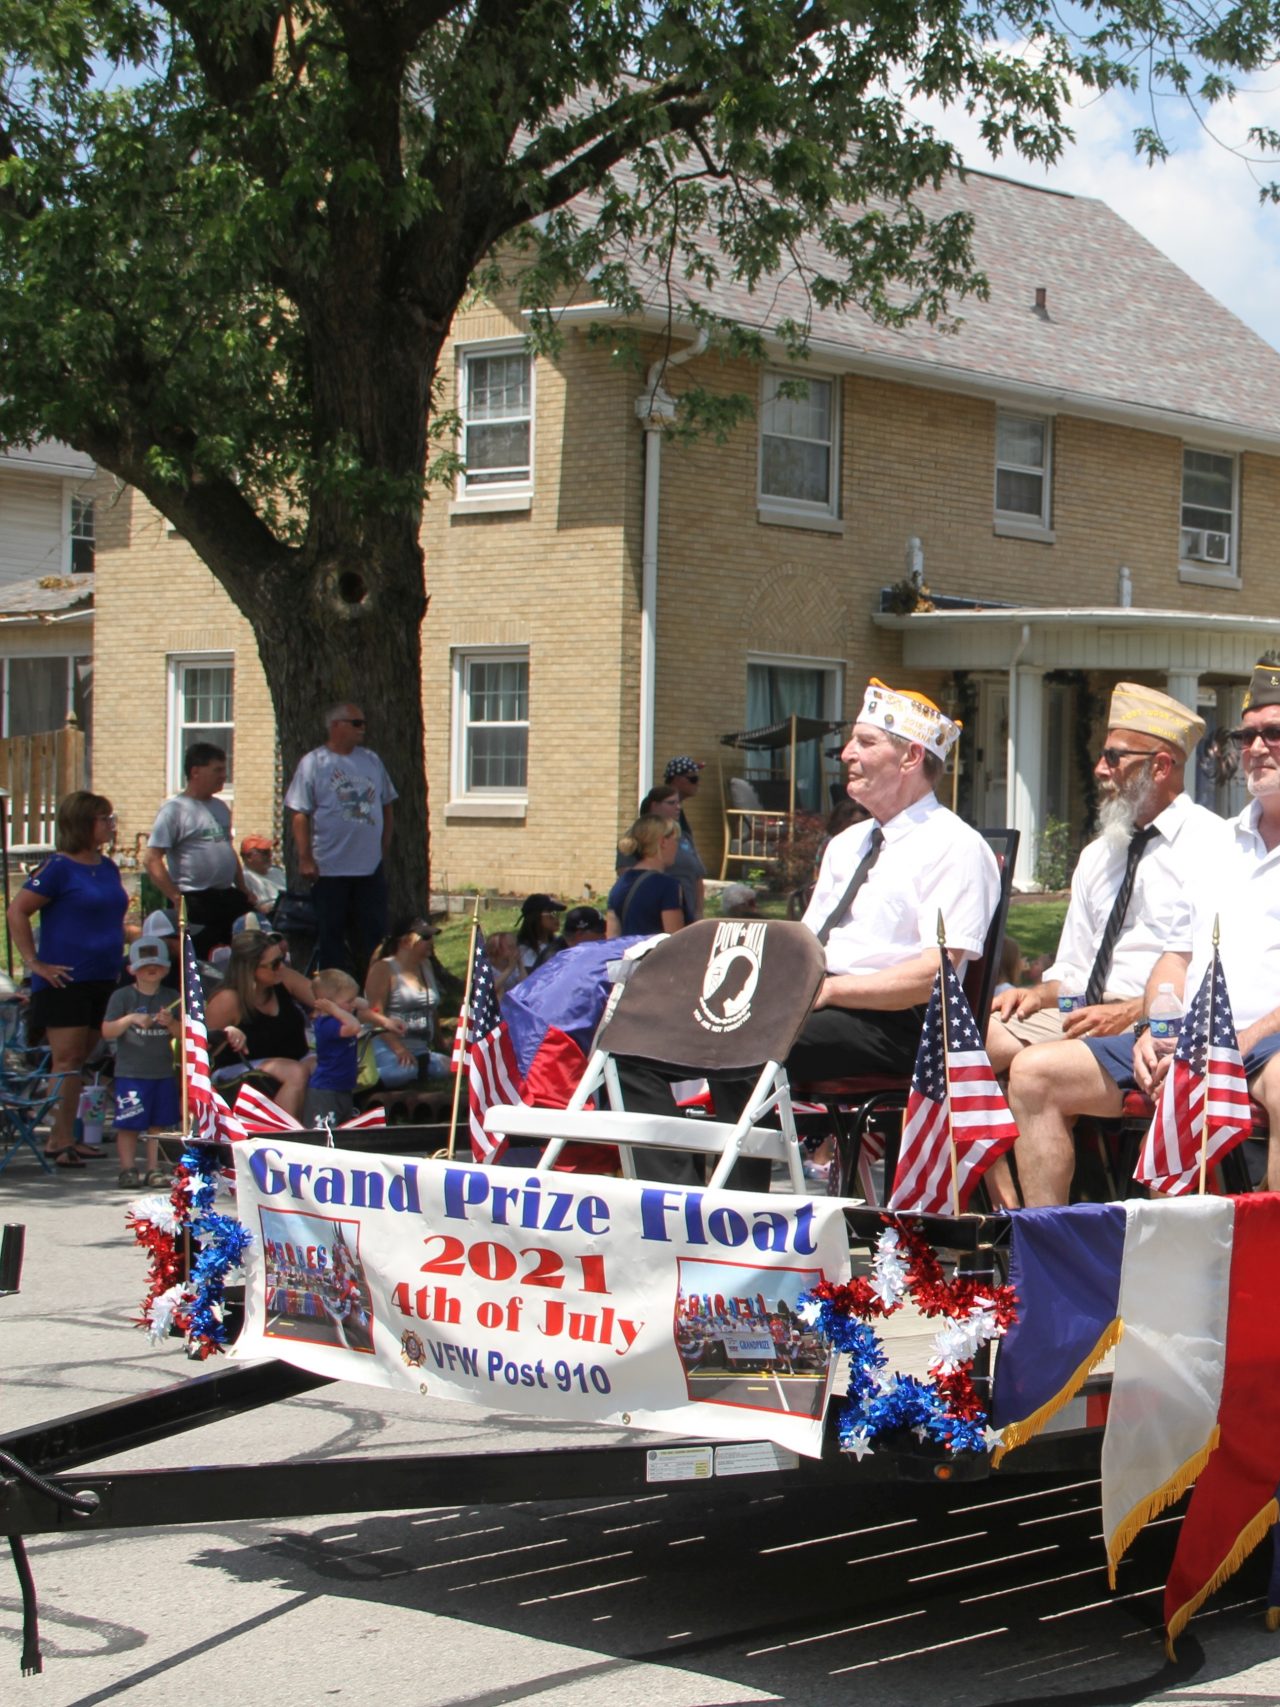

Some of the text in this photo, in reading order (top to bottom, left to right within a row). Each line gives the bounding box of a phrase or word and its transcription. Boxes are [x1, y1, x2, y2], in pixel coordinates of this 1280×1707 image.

[708, 922, 743, 968] POW
[248, 1147, 819, 1257] Grand Prize Float
[420, 1235, 613, 1295] 2021
[391, 1281, 462, 1325] 4th
[477, 1296, 524, 1330] of
[538, 1300, 645, 1356] July
[427, 1338, 613, 1396] VFW Post 910
